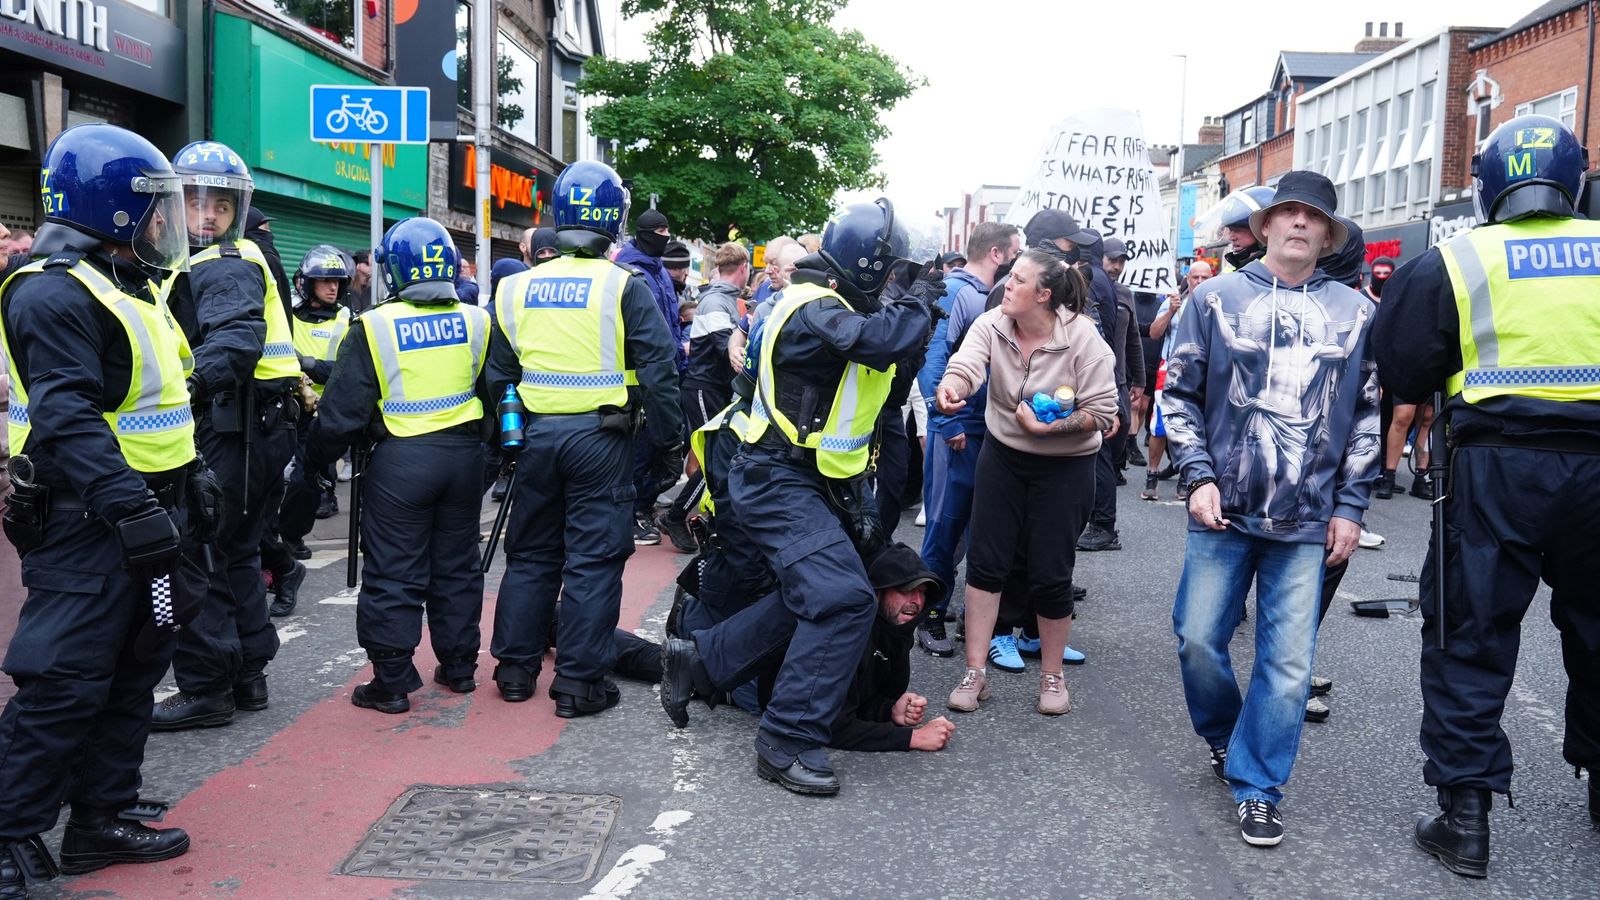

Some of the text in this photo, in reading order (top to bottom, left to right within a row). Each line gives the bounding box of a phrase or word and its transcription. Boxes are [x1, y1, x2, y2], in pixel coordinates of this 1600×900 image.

[114, 35, 153, 64] WORLD
[1067, 132, 1117, 157] FAR
[336, 160, 371, 185] ORIGINA
[1062, 160, 1125, 185] WHATS
[1508, 152, 1531, 177] M
[197, 175, 226, 186] POLICE
[569, 187, 593, 206] LZ
[1042, 192, 1121, 217] JONES
[1129, 195, 1144, 215] IS
[581, 207, 619, 221] 2075
[422, 245, 444, 262] LZ
[411, 264, 454, 280] 2976
[527, 281, 588, 303] POLICE
[399, 317, 464, 345] POLICE
